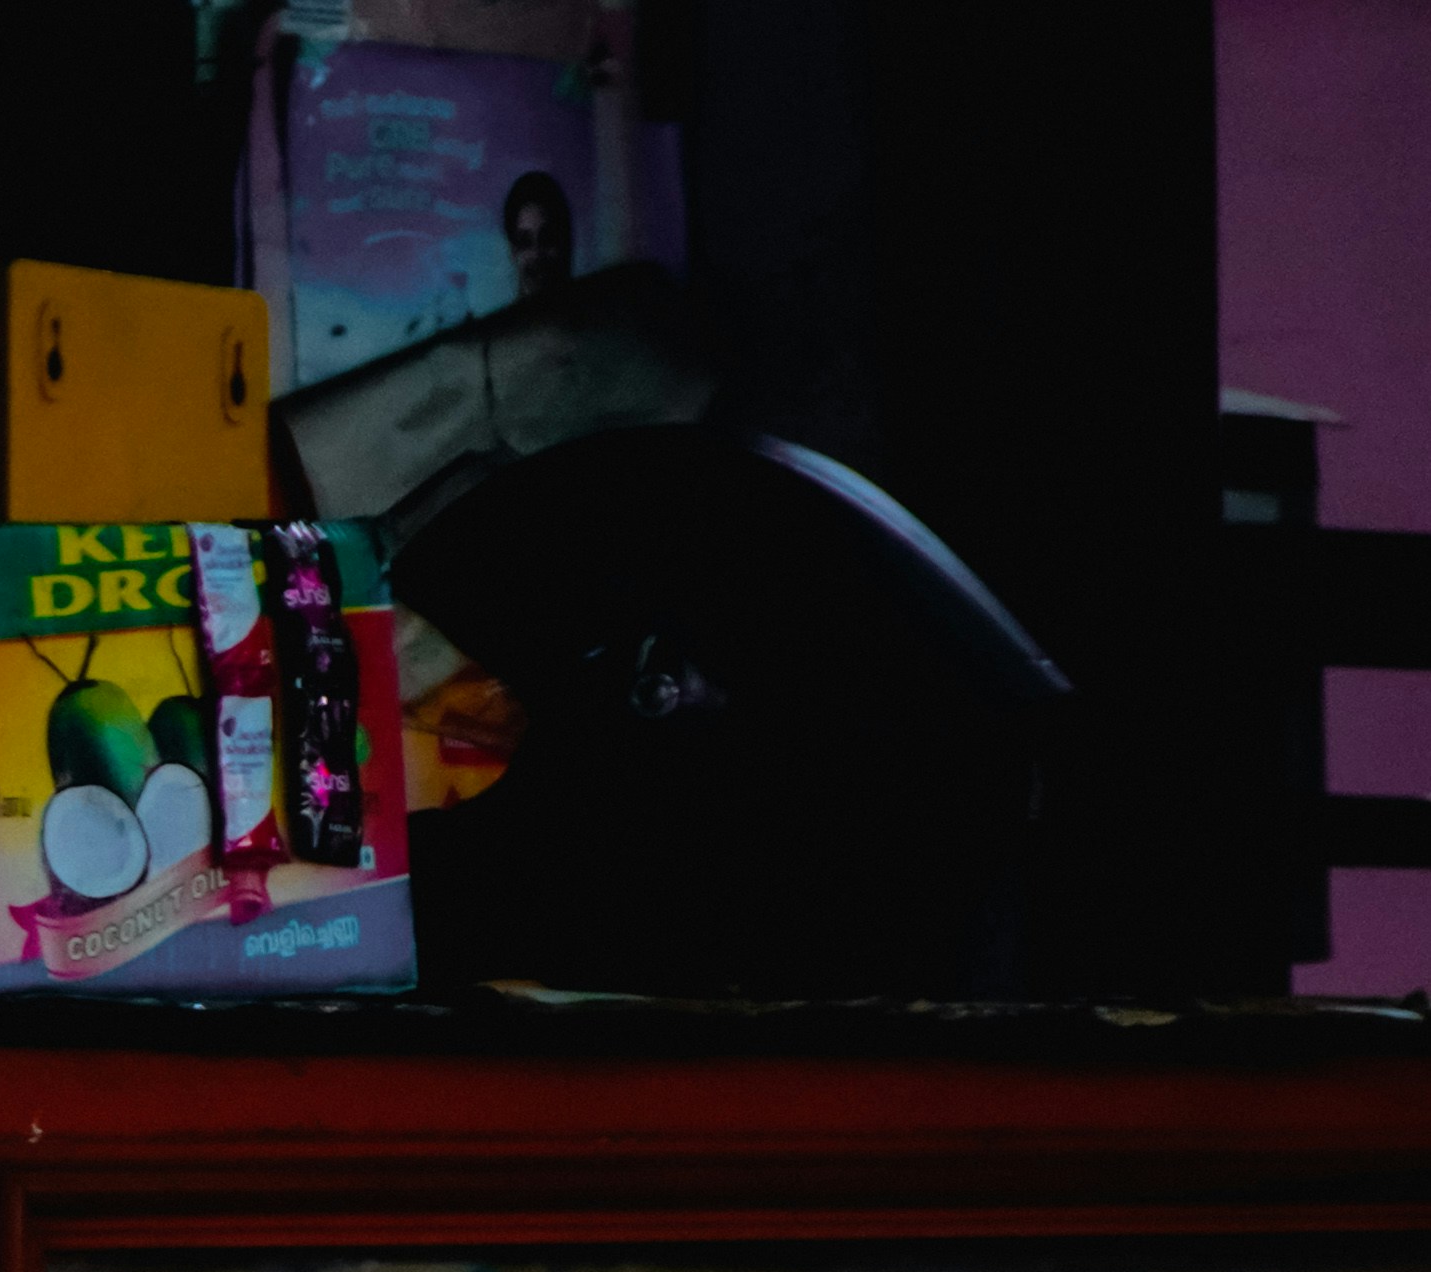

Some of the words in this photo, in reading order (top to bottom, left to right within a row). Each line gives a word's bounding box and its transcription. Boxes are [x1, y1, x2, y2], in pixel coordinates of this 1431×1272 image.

[58, 524, 192, 565] KE
[30, 562, 192, 618] DRO
[283, 584, 332, 610] sunsi
[308, 772, 352, 793] sunsi
[66, 891, 184, 962] COCONUT
[191, 866, 231, 901] OIL
